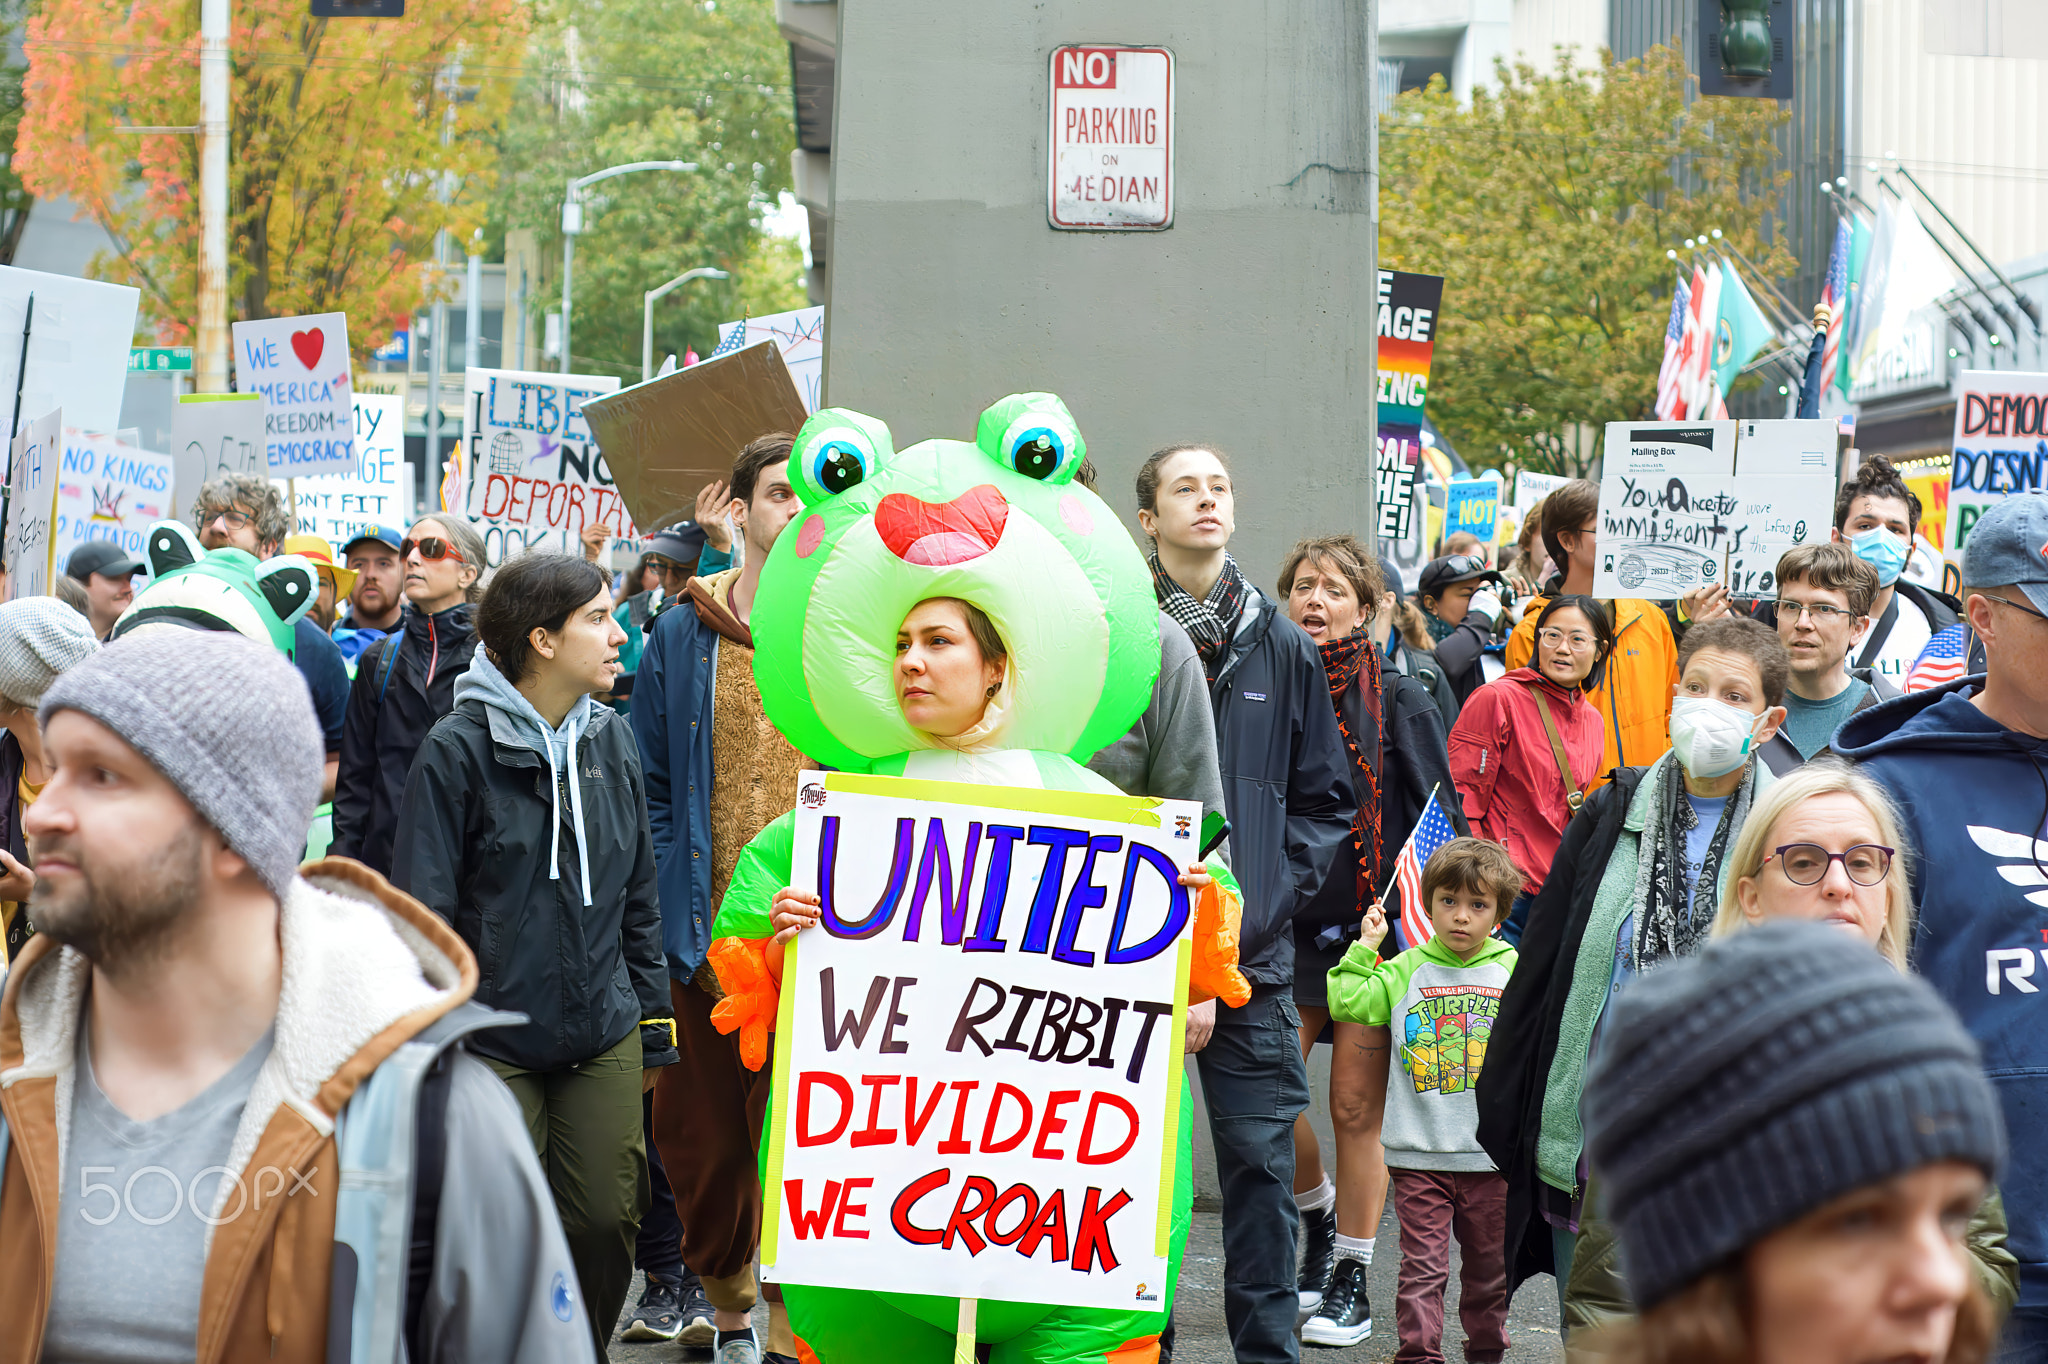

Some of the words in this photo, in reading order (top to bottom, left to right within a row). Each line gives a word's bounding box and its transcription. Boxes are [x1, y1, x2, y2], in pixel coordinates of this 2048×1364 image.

[1062, 51, 1110, 85] NO
[1066, 107, 1156, 144] PARKING
[1102, 154, 1118, 165] ON
[246, 337, 279, 370] WE
[488, 377, 606, 447] LIBE
[63, 447, 94, 474] NO
[102, 454, 168, 492] KINGS
[1631, 448, 1659, 457] Mailing
[1660, 447, 1676, 456] Box
[341, 494, 388, 514] FIT
[482, 474, 635, 540] DEPORTA
[1458, 498, 1497, 525] NOT
[817, 815, 1190, 967] UNITED
[1408, 993, 1501, 1025] TURTLE
[1422, 987, 1457, 997] TEENAGE
[1457, 986, 1486, 996] MUTANT
[819, 966, 917, 1054] WE
[946, 977, 1173, 1084] RIBBIT
[796, 1071, 1140, 1165] DIVIDED
[784, 1177, 874, 1240] WE
[890, 1168, 1134, 1275] CROAK
